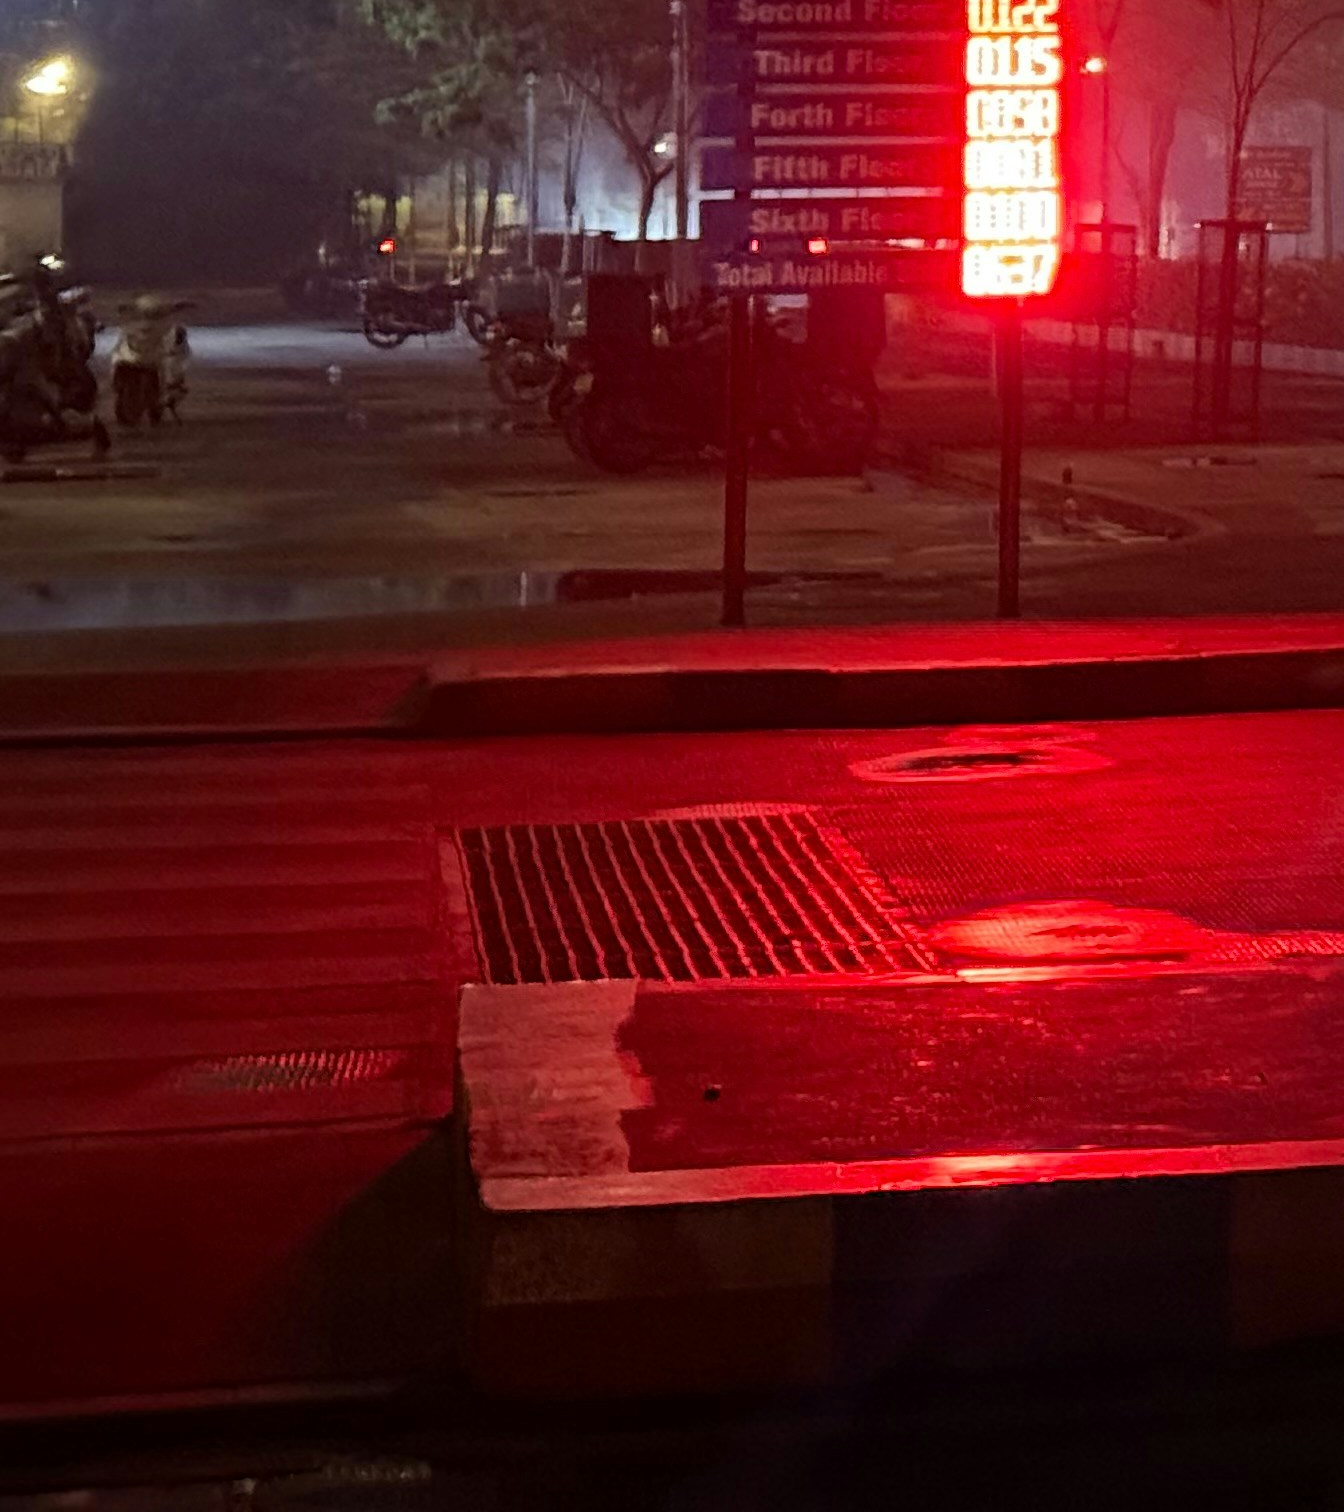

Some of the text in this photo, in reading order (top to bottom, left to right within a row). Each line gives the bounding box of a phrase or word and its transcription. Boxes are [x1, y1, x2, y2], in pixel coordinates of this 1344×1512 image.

[754, 49, 835, 76] Third
[967, 37, 1059, 85] 0115
[751, 102, 834, 129] Forth
[753, 154, 830, 181] Fifth
[749, 207, 830, 234] Sixth
[713, 259, 889, 287] Total Available
